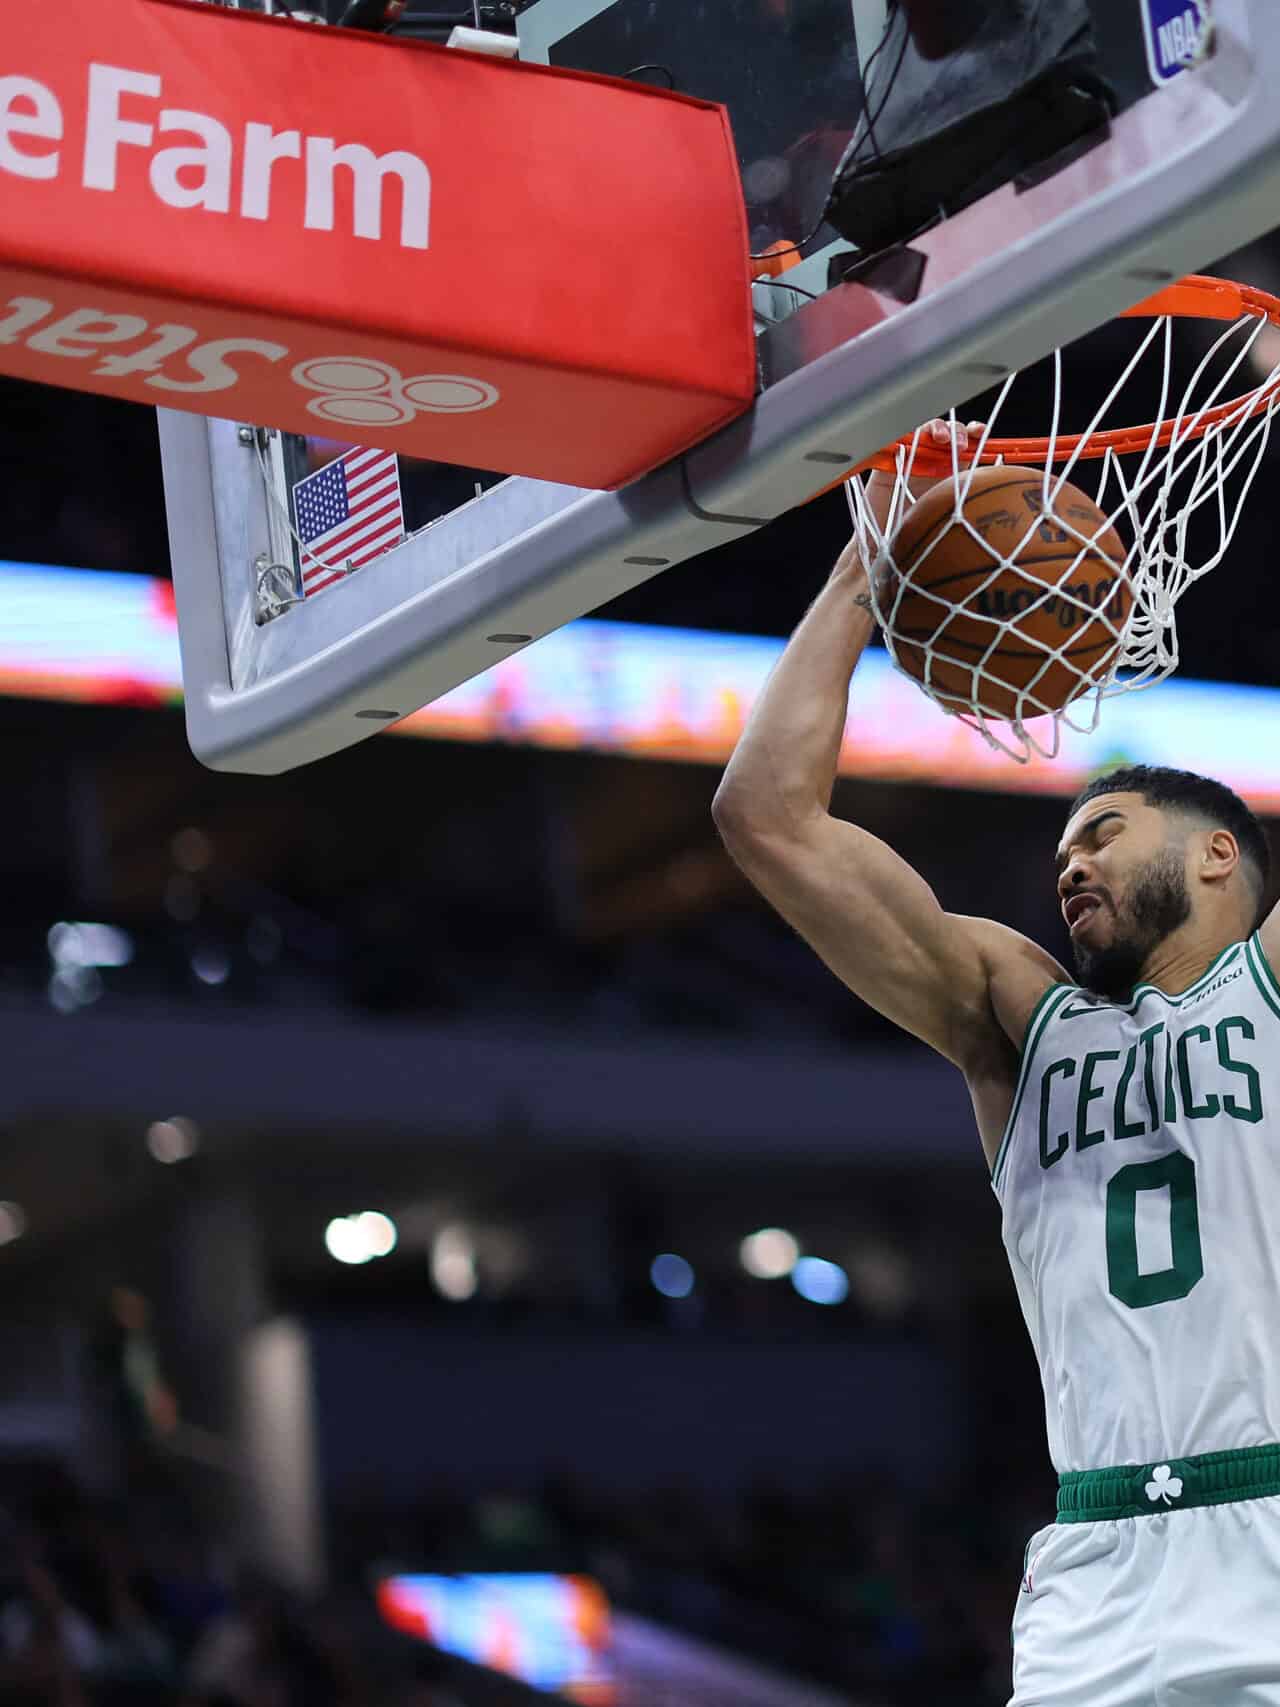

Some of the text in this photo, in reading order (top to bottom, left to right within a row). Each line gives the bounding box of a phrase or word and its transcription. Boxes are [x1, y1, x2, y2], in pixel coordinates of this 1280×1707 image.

[1157, 9, 1202, 68] NBA
[82, 62, 432, 250] Farm
[1039, 1016, 1264, 1169] CELTICS
[1105, 1150, 1204, 1309] 0
